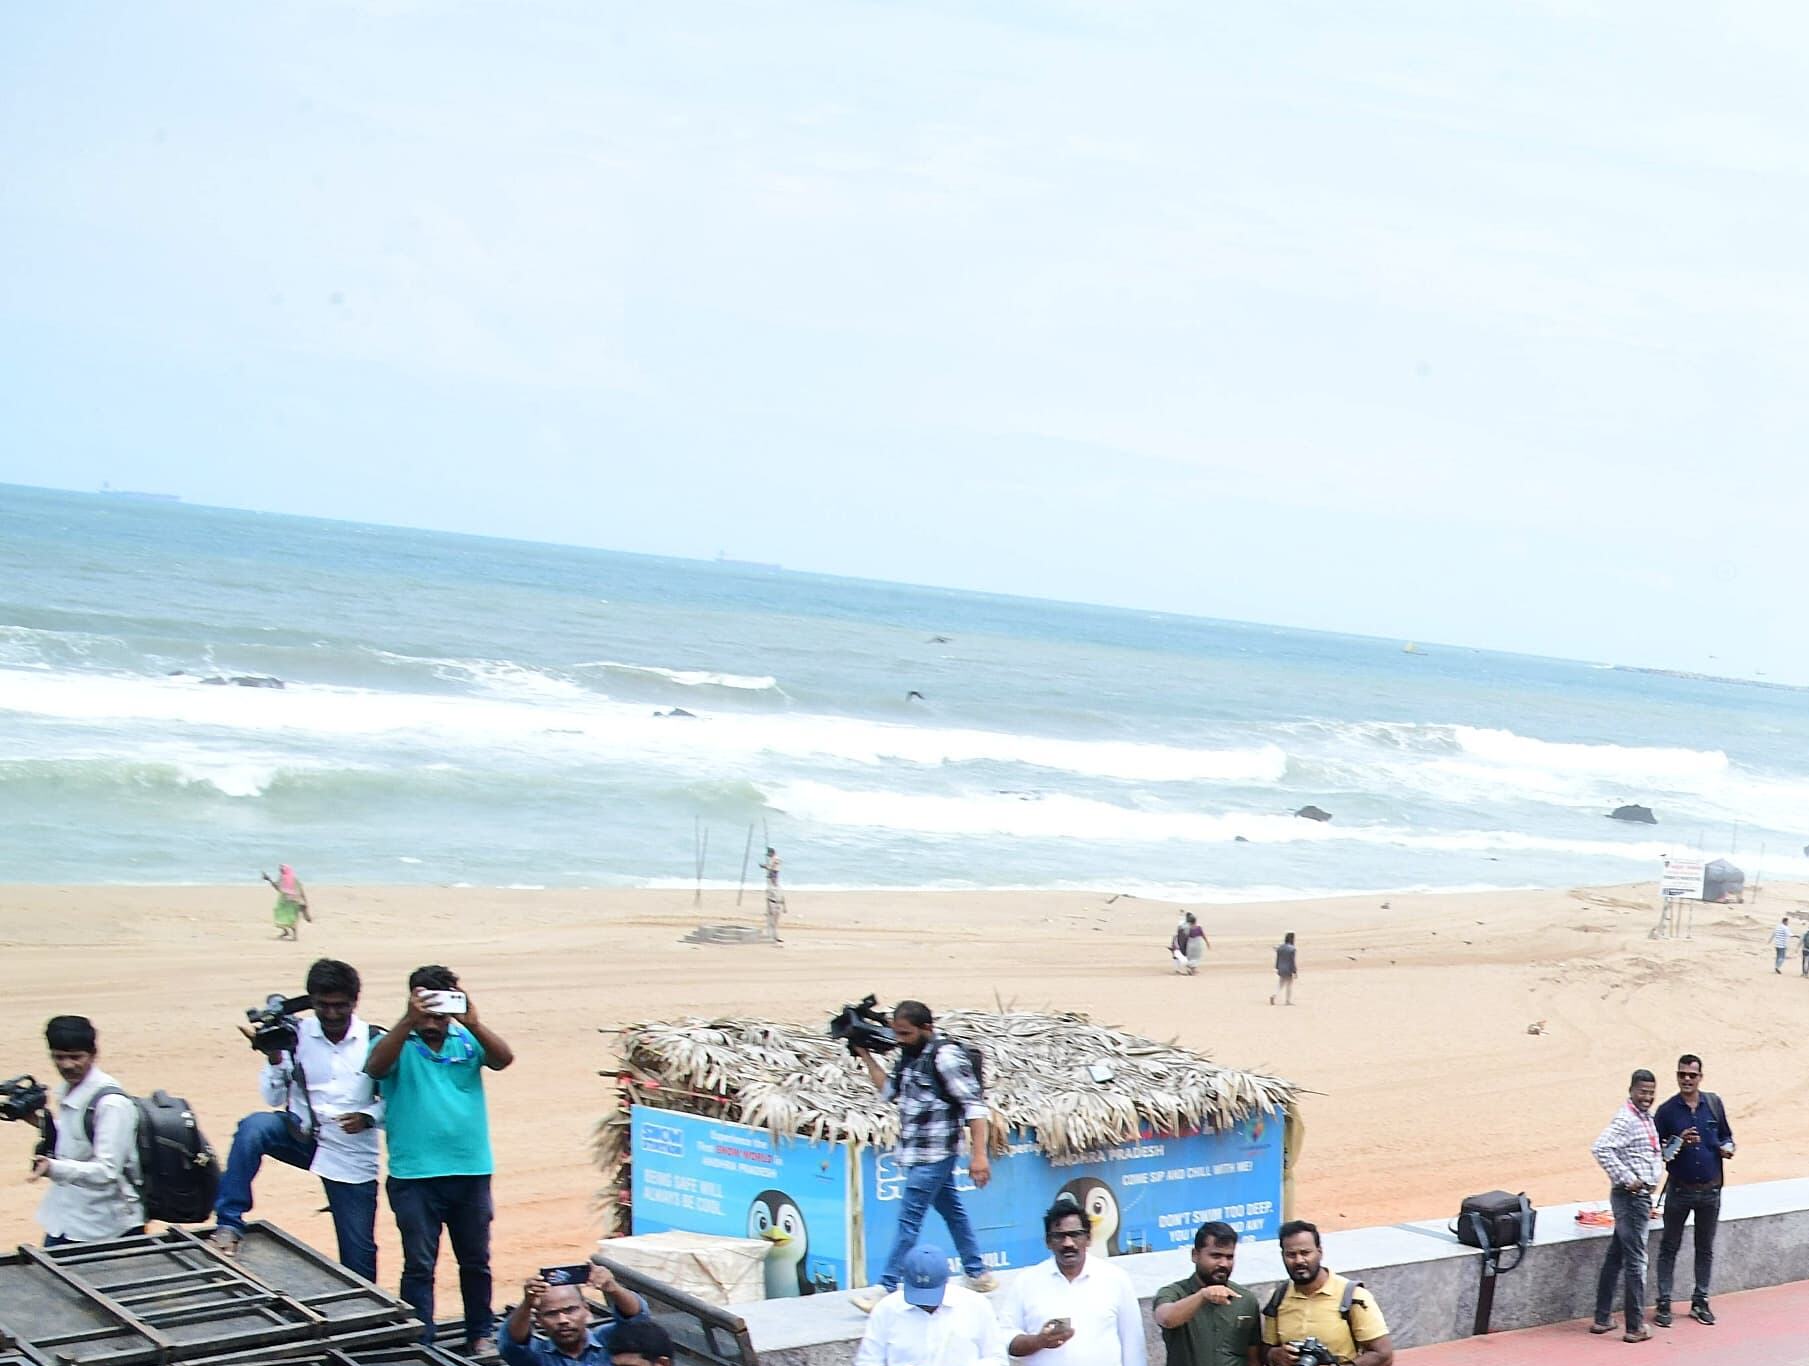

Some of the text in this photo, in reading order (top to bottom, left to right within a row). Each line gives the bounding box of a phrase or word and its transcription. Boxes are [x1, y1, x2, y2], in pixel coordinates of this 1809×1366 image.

[1108, 1145, 1165, 1162] PRADESH
[1121, 1172, 1149, 1186] COME
[1166, 1168, 1186, 1181] AND
[1186, 1166, 1213, 1179] CHILL
[1213, 1163, 1236, 1175] WITH
[1158, 1200, 1274, 1228] DON'T SWIM TOO DEEP.
[1246, 1218, 1265, 1231] ANY
